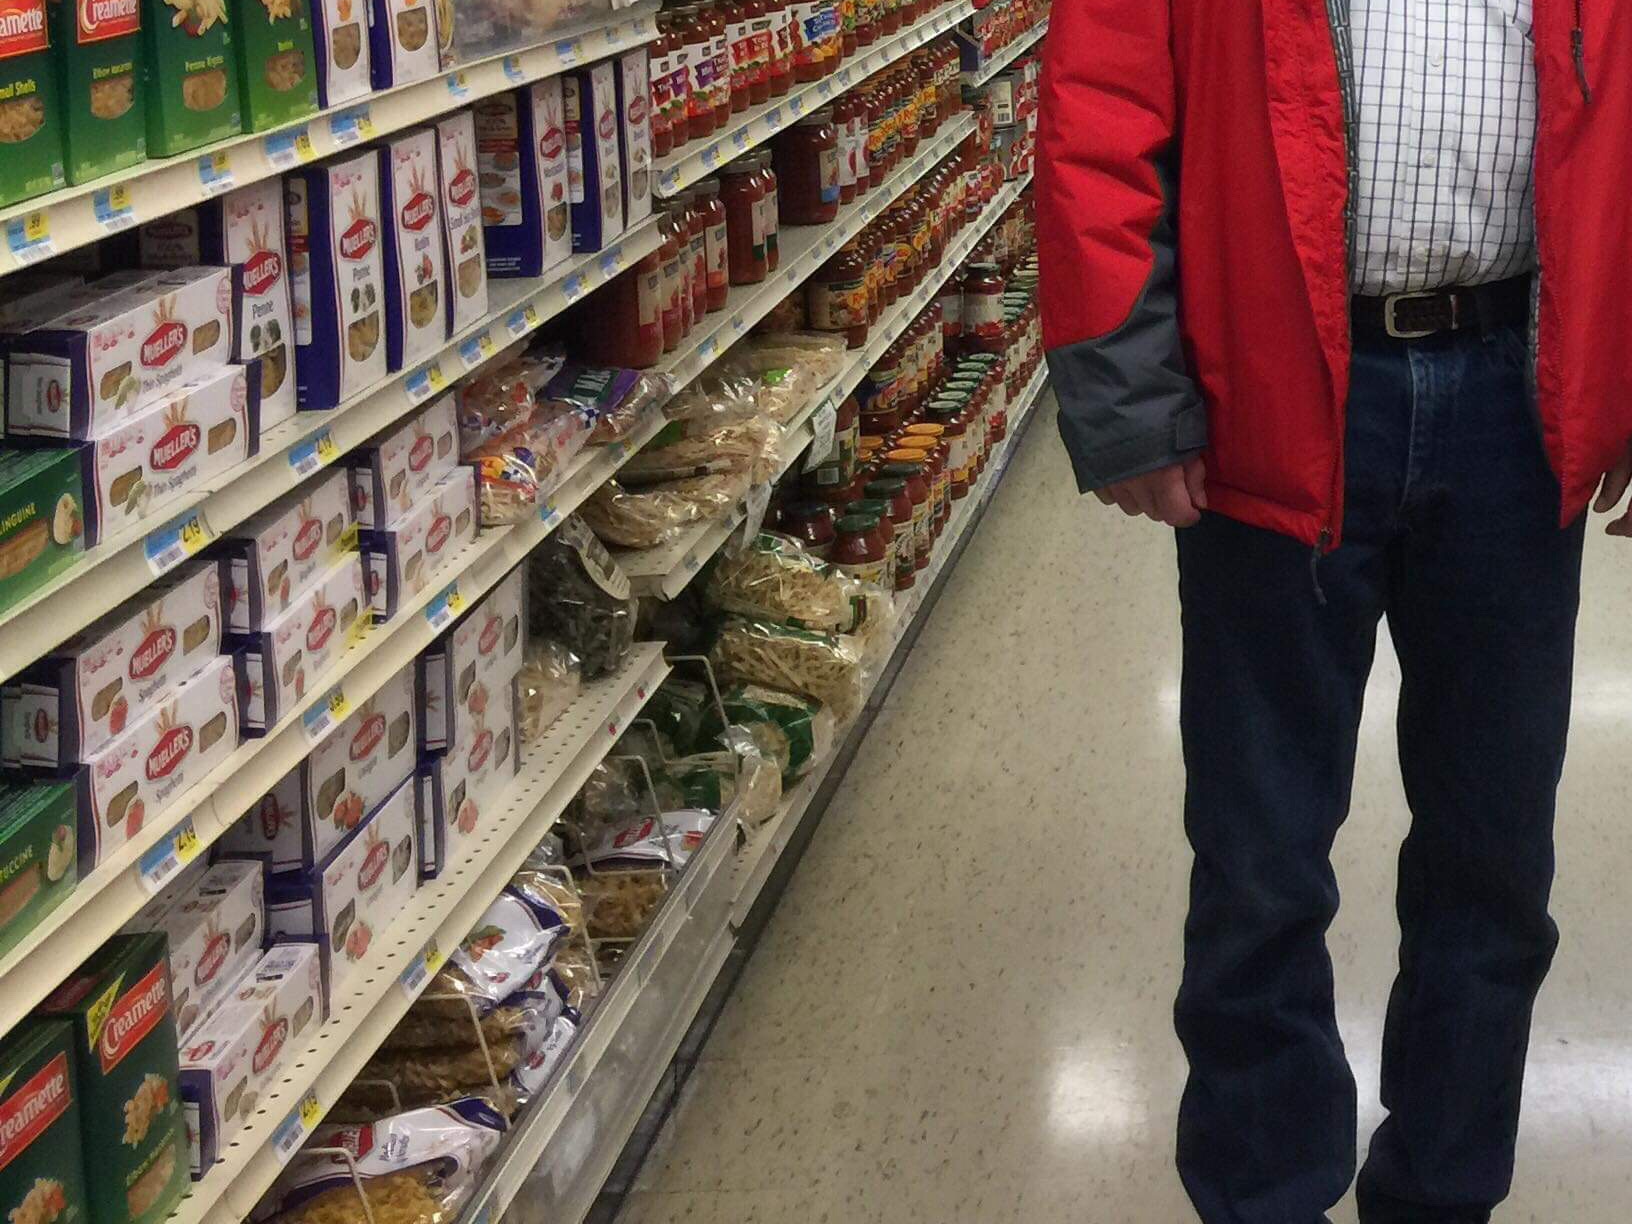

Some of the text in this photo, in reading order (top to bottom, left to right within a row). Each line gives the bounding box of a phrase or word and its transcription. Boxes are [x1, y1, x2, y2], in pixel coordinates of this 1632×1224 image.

[0, 6, 43, 37] amette
[142, 328, 185, 363] MUELLER'S
[153, 428, 198, 467] MUELLER'S
[131, 632, 174, 675] MUELLER'S
[147, 730, 191, 778] MUELLER'S
[102, 979, 167, 1055] Creamette
